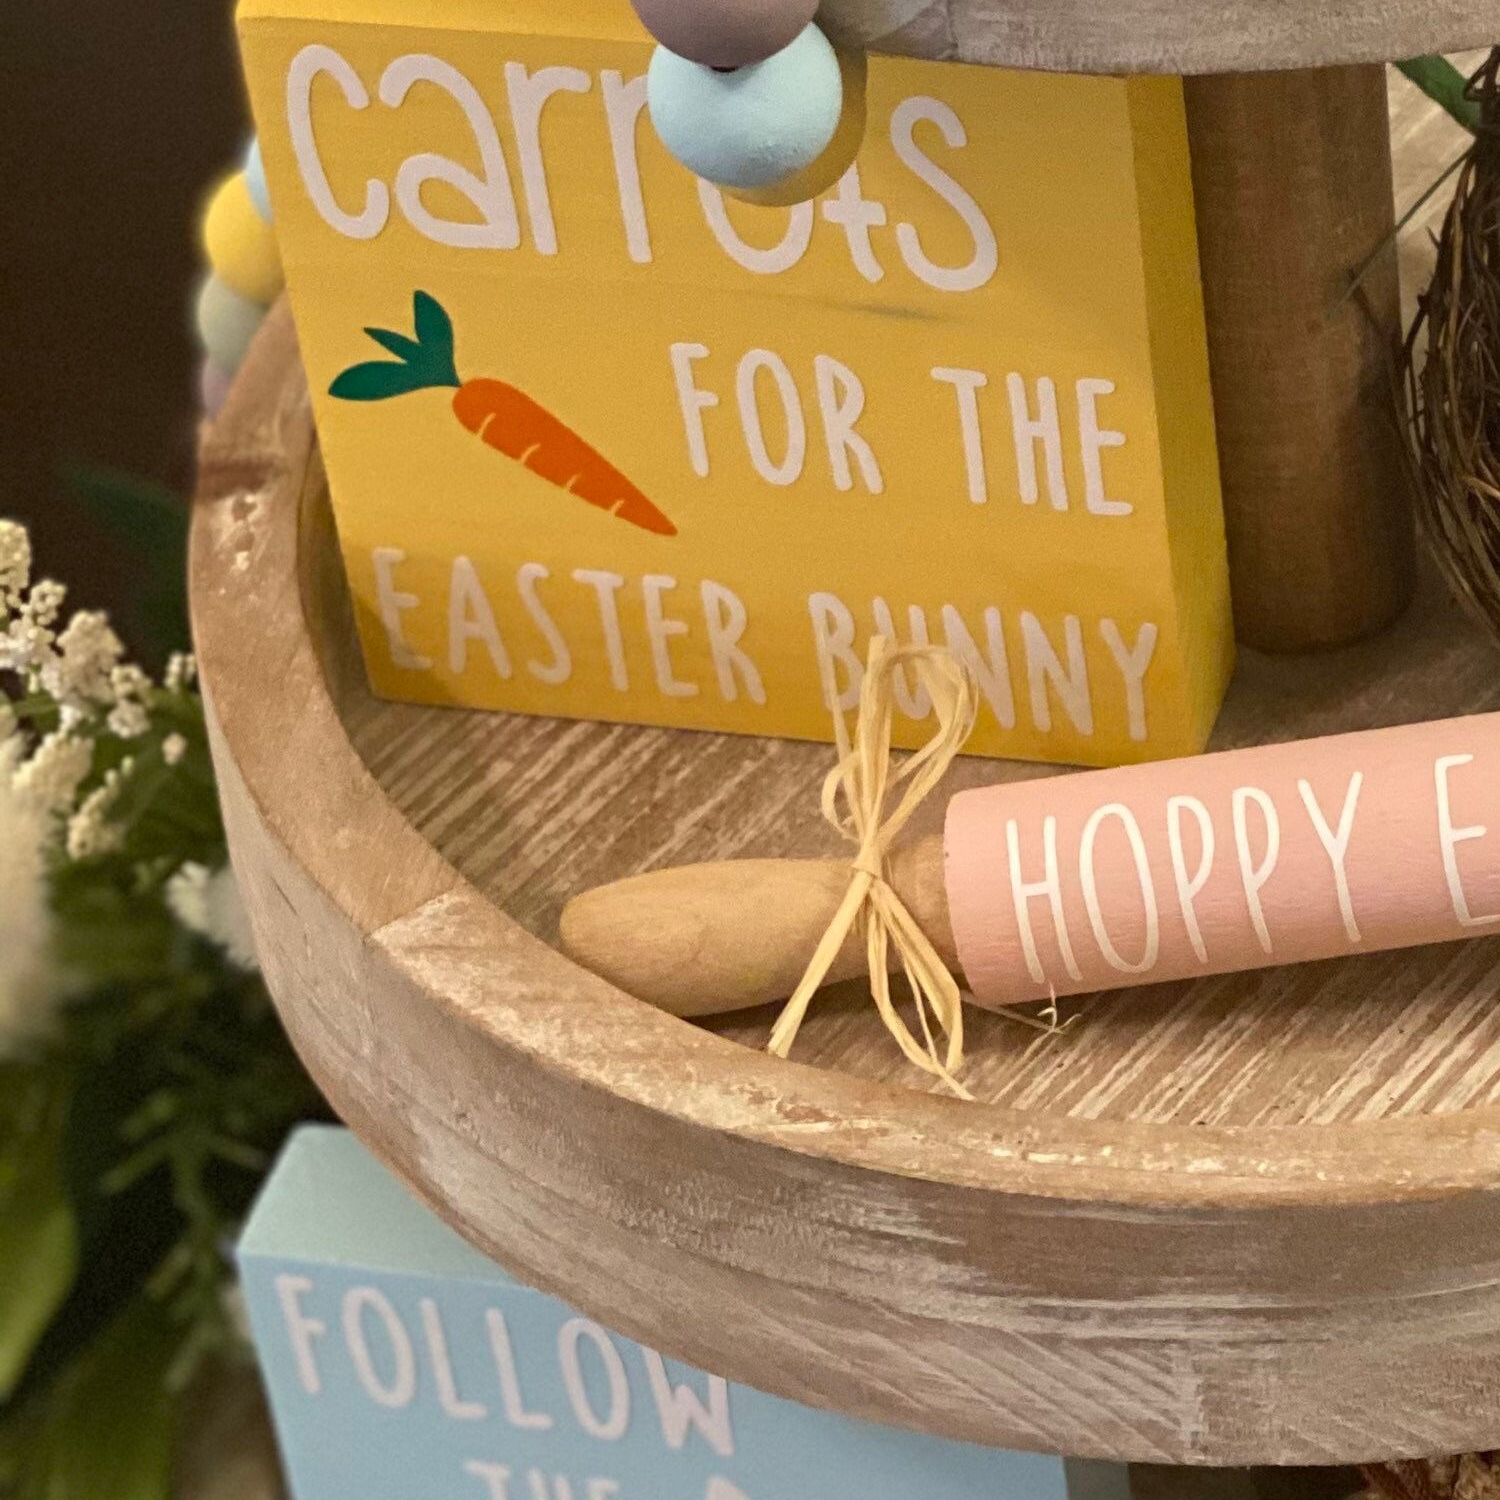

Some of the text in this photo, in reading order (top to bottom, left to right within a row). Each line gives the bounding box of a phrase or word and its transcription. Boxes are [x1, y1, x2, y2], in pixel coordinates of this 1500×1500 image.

[669, 342, 1134, 518] FOR THE
[371, 547, 1158, 743] EASTER BUNNY
[1004, 770, 1364, 986] HOPPY
[273, 1273, 736, 1458] FOLLOW
